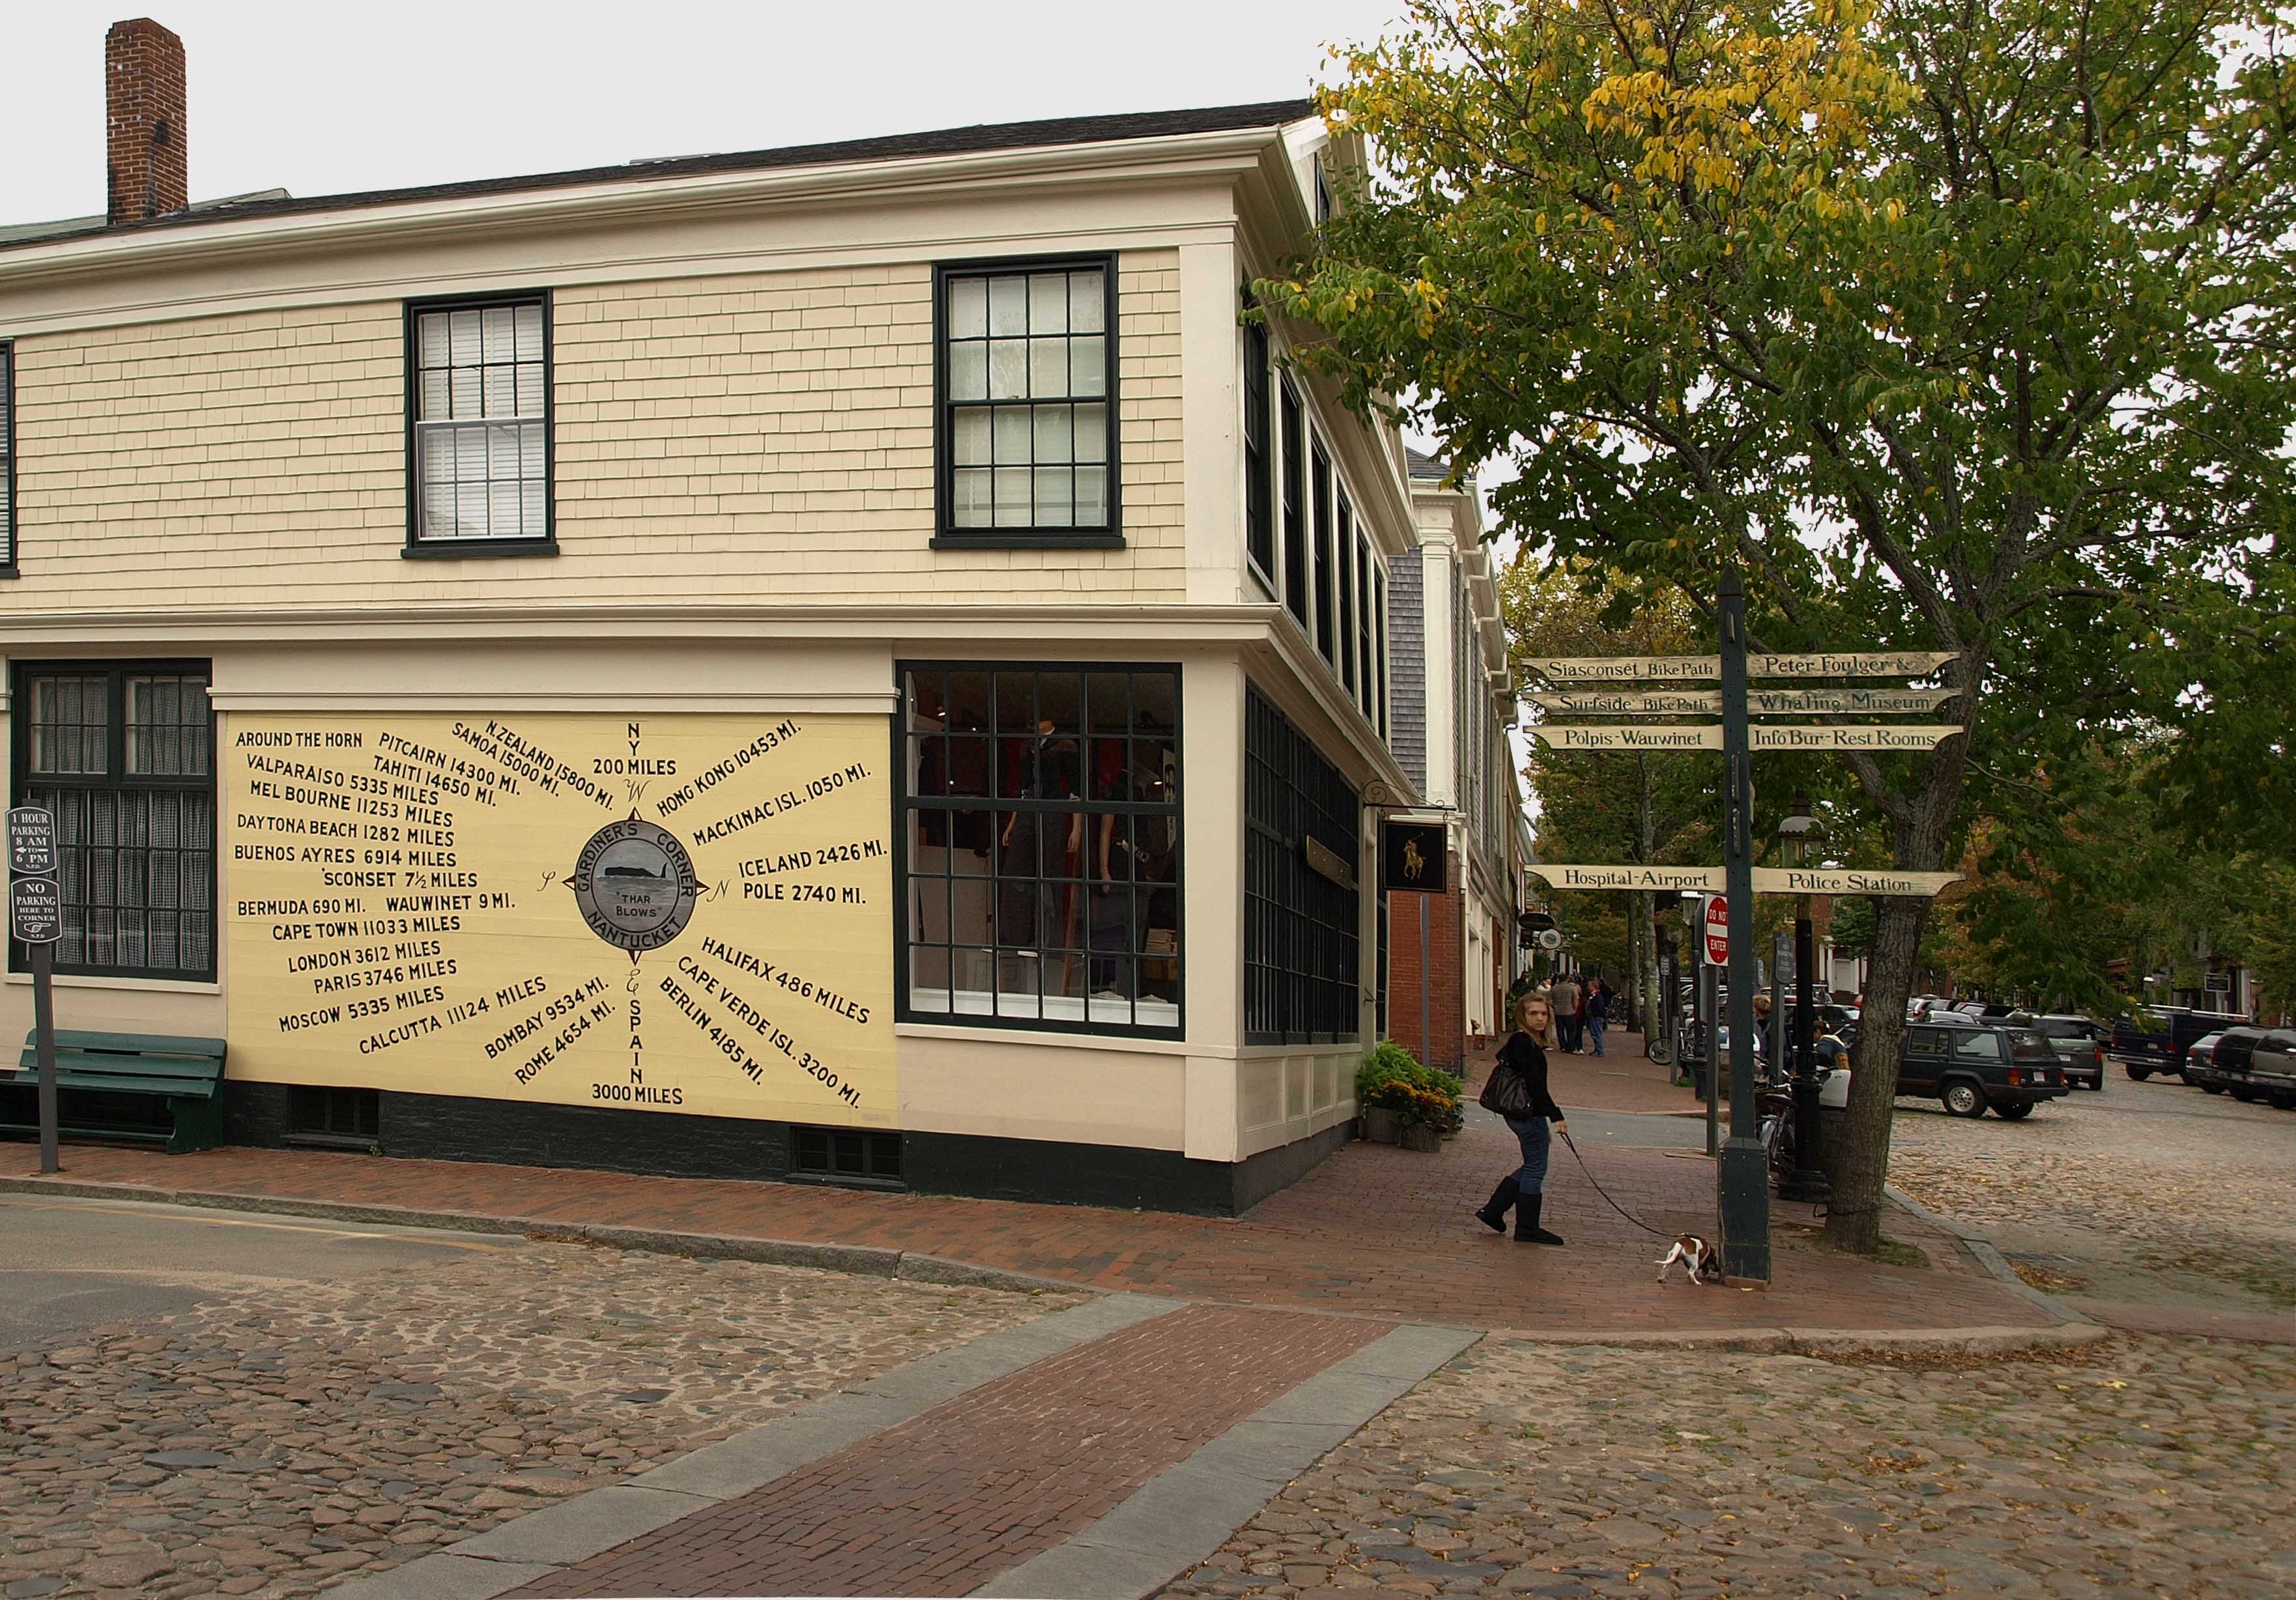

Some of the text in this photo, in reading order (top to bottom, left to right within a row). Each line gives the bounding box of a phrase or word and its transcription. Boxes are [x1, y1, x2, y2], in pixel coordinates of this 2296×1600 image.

[1549, 662, 1713, 677] Siasconset Bike Path
[1764, 657, 1910, 674] Peter Foulger &
[1560, 696, 1708, 711] Surfside Bike Path
[1759, 693, 1932, 712] Whaling Museum
[237, 732, 362, 747] AROUND THE HORN
[1755, 730, 1786, 745] Info
[1876, 730, 1935, 746] Rooms
[379, 732, 521, 795] PITCAIRN 14300 MI.
[452, 722, 559, 797] SAMOA 15000 MI.
[593, 759, 676, 775] 200 MILES
[657, 719, 802, 818] HONG KONG 10453 MI.
[247, 754, 438, 806] VALPARAISO 5335 MILES
[373, 756, 497, 807] TAHITI 14650 MI.
[554, 764, 594, 796] 15800
[595, 789, 613, 810] MI.
[624, 779, 648, 803] W
[357, 799, 398, 818] 11253
[405, 805, 452, 827] MILES
[693, 763, 871, 846] MACKINAC ISL. 1050 MI.
[13, 814, 48, 823] 1 HOUR
[12, 826, 50, 835] PARKING
[16, 837, 46, 846] 8 AM
[238, 814, 454, 847] DAYTONA BEACH 1282 MILES
[30, 855, 48, 863] PM
[235, 845, 457, 866] BUENOS AYRES 6914 MILES
[578, 823, 693, 897] GARDINER'S CORNER
[739, 839, 887, 877] ICELAND 2426 MI.
[26, 883, 45, 893] NO
[431, 872, 478, 887] MILES
[1788, 873, 1911, 891] Police Station
[17, 896, 56, 906] PARKING
[386, 893, 515, 912] WAUWINET 9 MI.
[744, 883, 866, 904] POLE 2740 MI.
[238, 898, 366, 916] BERMUDA 690 MI.
[1709, 909, 1716, 920] DO
[273, 917, 461, 940] CAPE TOWN 11033 MILES
[588, 911, 680, 948] NANTUCKET
[1711, 939, 1727, 951] ENTER
[288, 941, 440, 973] LONDON 3612 MILES
[315, 960, 457, 993] PARIS 3746 MILES
[701, 936, 870, 1024] HALIFAX 486 MILES
[279, 986, 444, 1032] MOSCOW 5335 MILES
[360, 977, 547, 1053] CALCUTTA 11124 MILES
[485, 977, 609, 1059] BOMBAY 9534 MI.
[630, 999, 642, 1084] SPAIN
[659, 976, 762, 1085] BERLIN 4185 MI.
[678, 956, 860, 1109] CAPE VERDE ISL. 3200 MI.
[515, 1001, 615, 1085] ROME 4654 MI.
[592, 1083, 682, 1104] 3000 MILES
